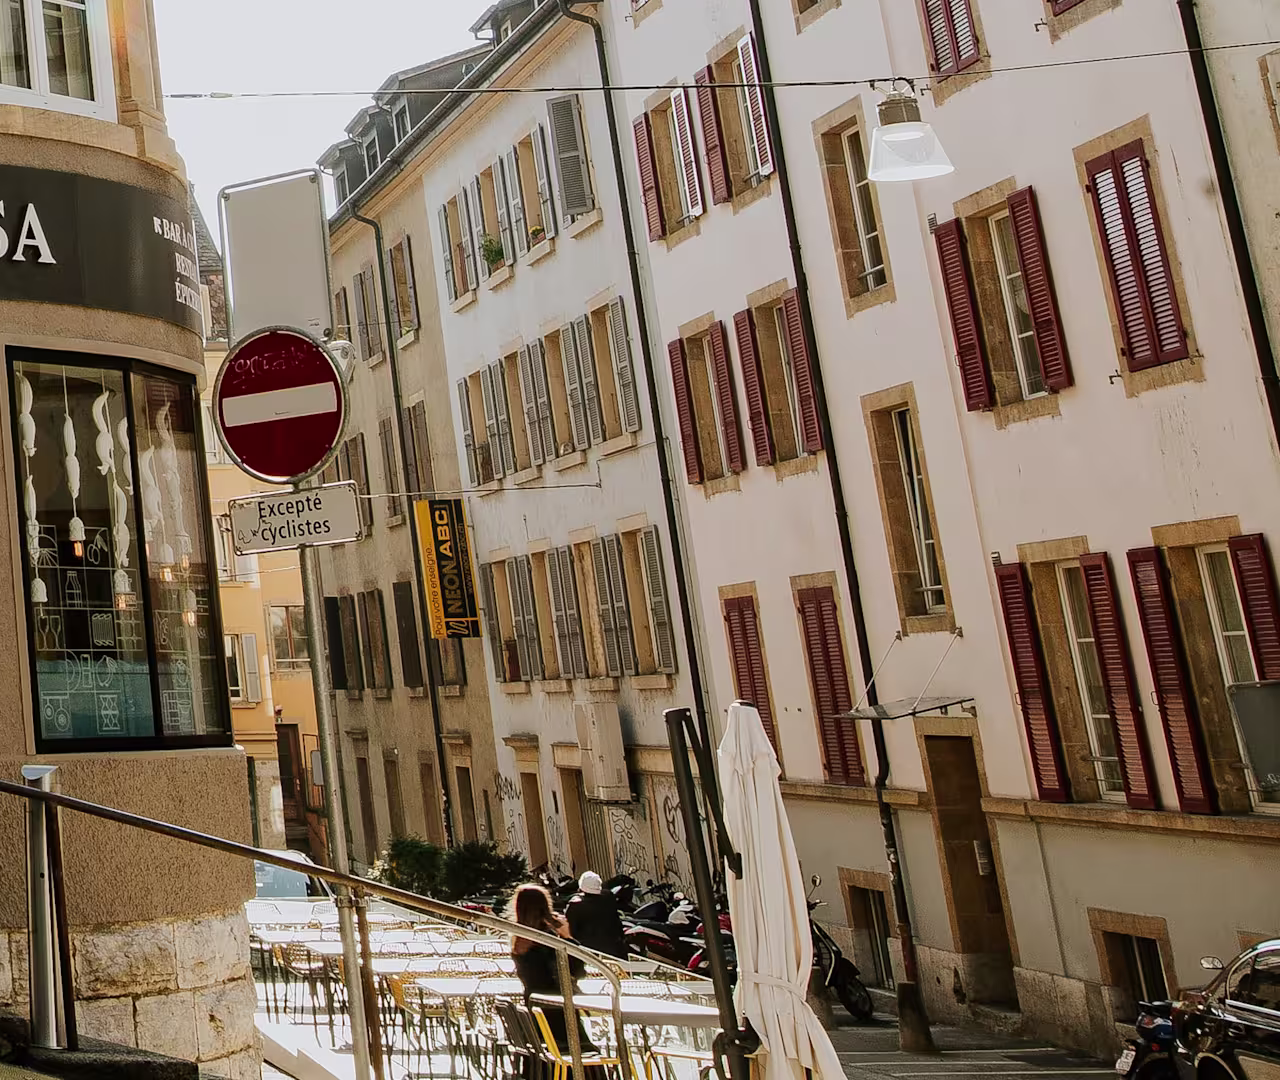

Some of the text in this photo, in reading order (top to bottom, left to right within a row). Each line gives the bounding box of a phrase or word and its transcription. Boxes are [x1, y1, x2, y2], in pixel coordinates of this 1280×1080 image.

[162, 218, 181, 245] BAR
[257, 492, 322, 519] Excepté
[261, 519, 331, 545] cyclistes
[431, 590, 441, 613] votre
[434, 615, 444, 636] Pour
